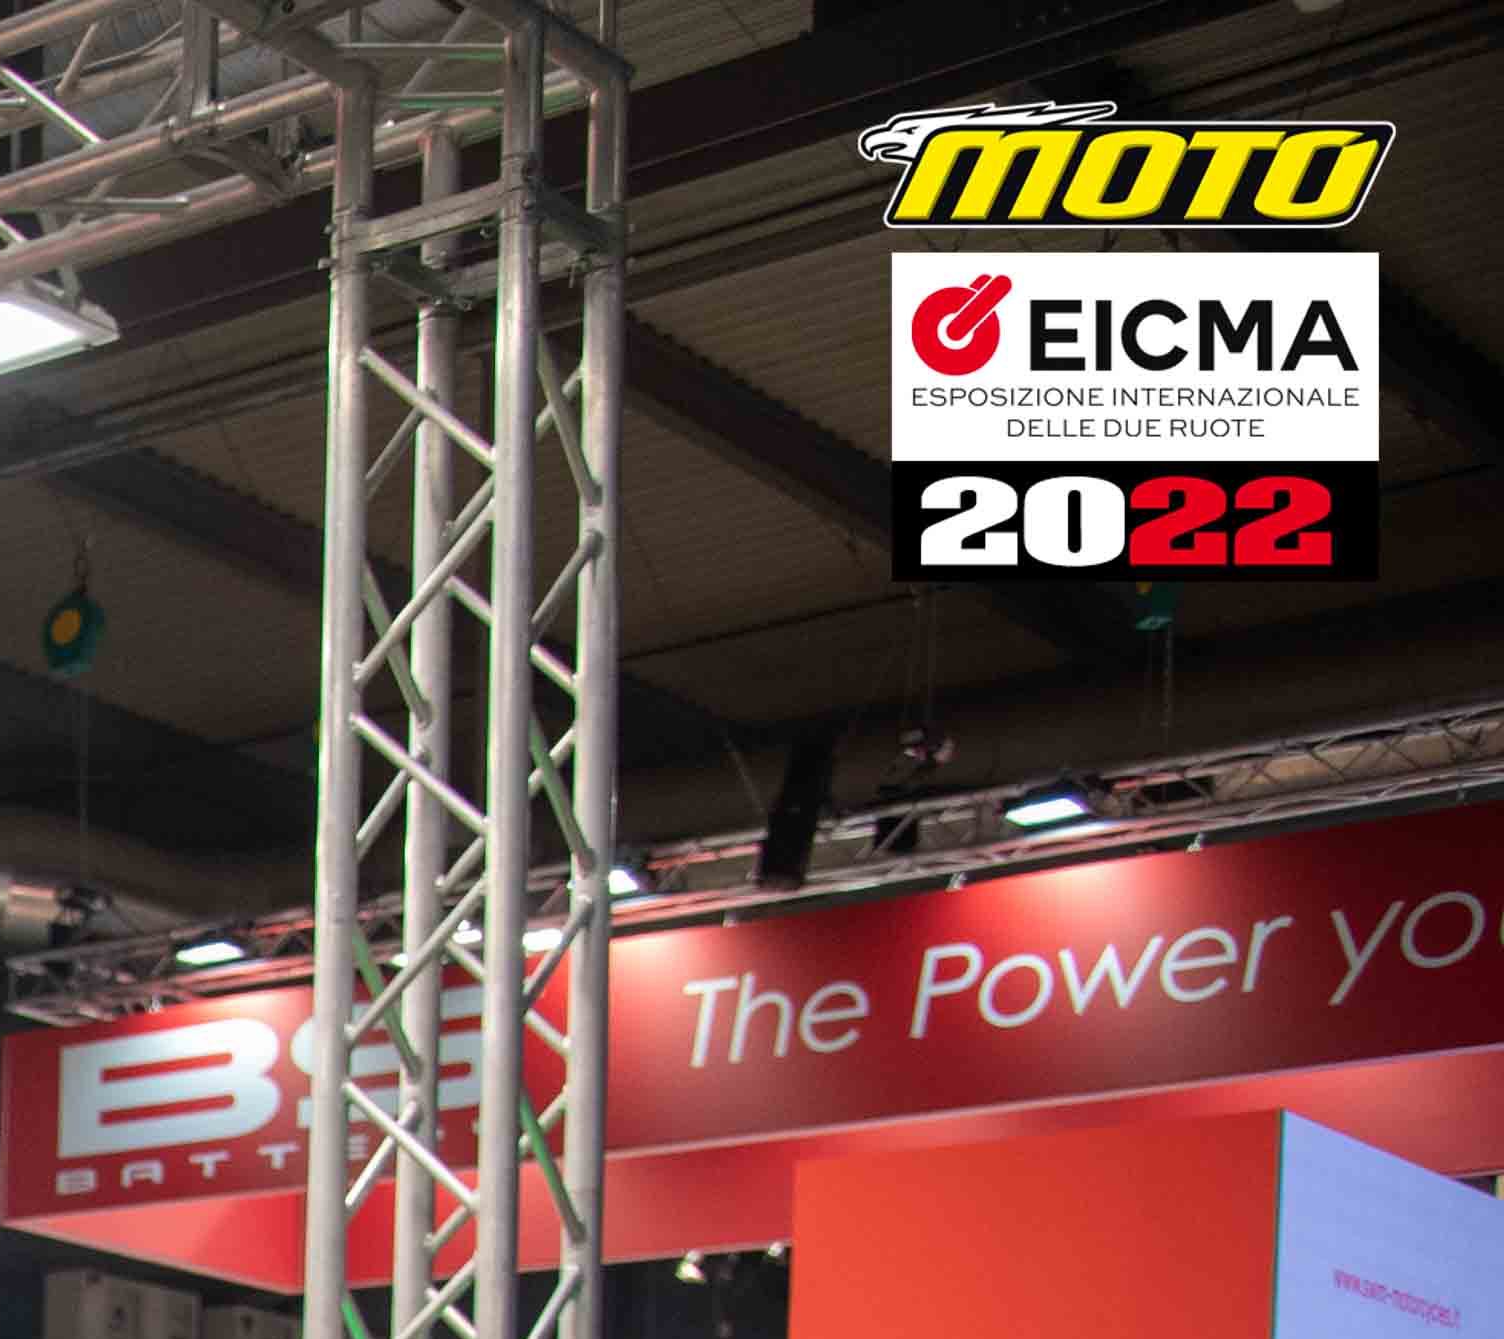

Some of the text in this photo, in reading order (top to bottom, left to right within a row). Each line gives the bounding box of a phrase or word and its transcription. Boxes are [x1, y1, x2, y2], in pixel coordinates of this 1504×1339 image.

[683, 889, 1504, 1068] The Power yo
